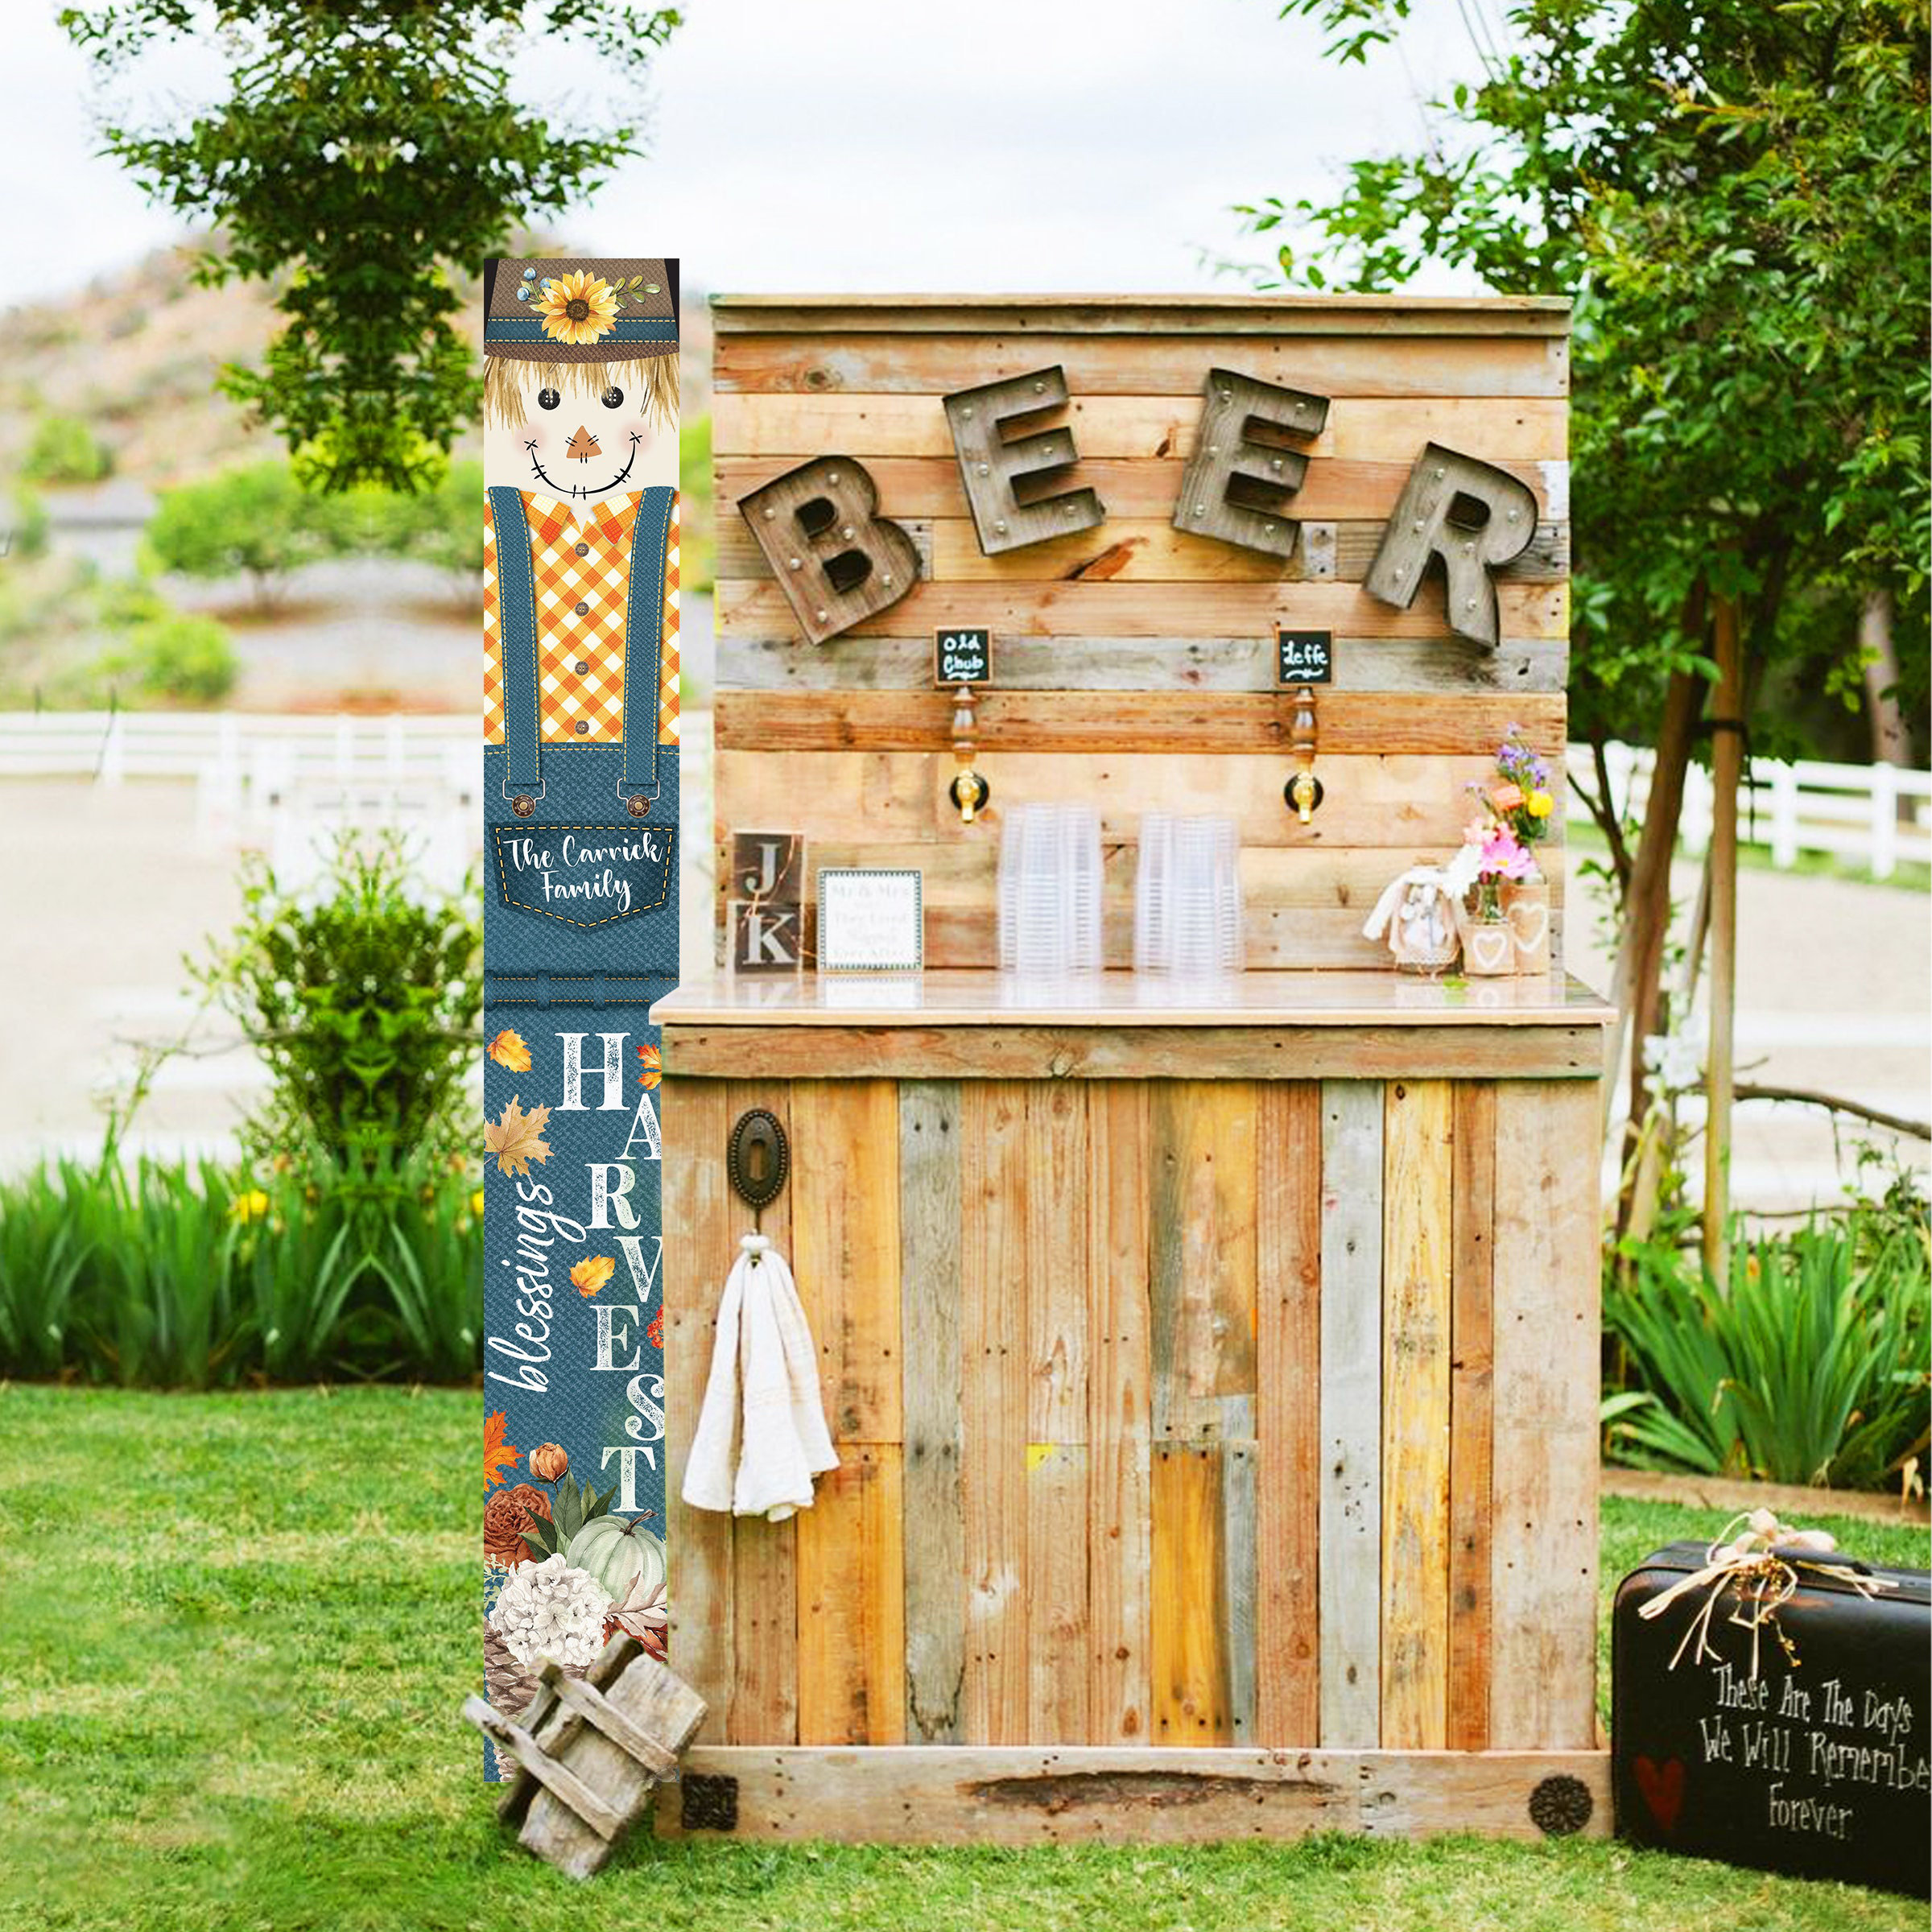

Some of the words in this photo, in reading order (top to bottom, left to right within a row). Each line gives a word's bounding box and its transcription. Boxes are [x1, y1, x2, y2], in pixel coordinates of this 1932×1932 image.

[737, 365, 1539, 646] BEER
[943, 634, 981, 651] Old
[943, 654, 984, 673] Chub
[1282, 640, 1328, 665] Leffe
[503, 838, 554, 872] The
[562, 832, 663, 867] Carrick
[745, 843, 782, 894] J
[540, 869, 633, 912] Family
[742, 913, 799, 965] K
[487, 1175, 587, 1393] blessings
[554, 1032, 665, 1513] HARVEST
[1712, 1662, 1769, 1710] These
[1777, 1674, 1810, 1722] Are
[1822, 1679, 1854, 1727] The
[1864, 1690, 1913, 1746] Days
[1700, 1715, 1732, 1762] We
[1743, 1721, 1790, 1773] Will
[1810, 1731, 1931, 1794] Remembe
[1769, 1781, 1852, 1839] Forever
